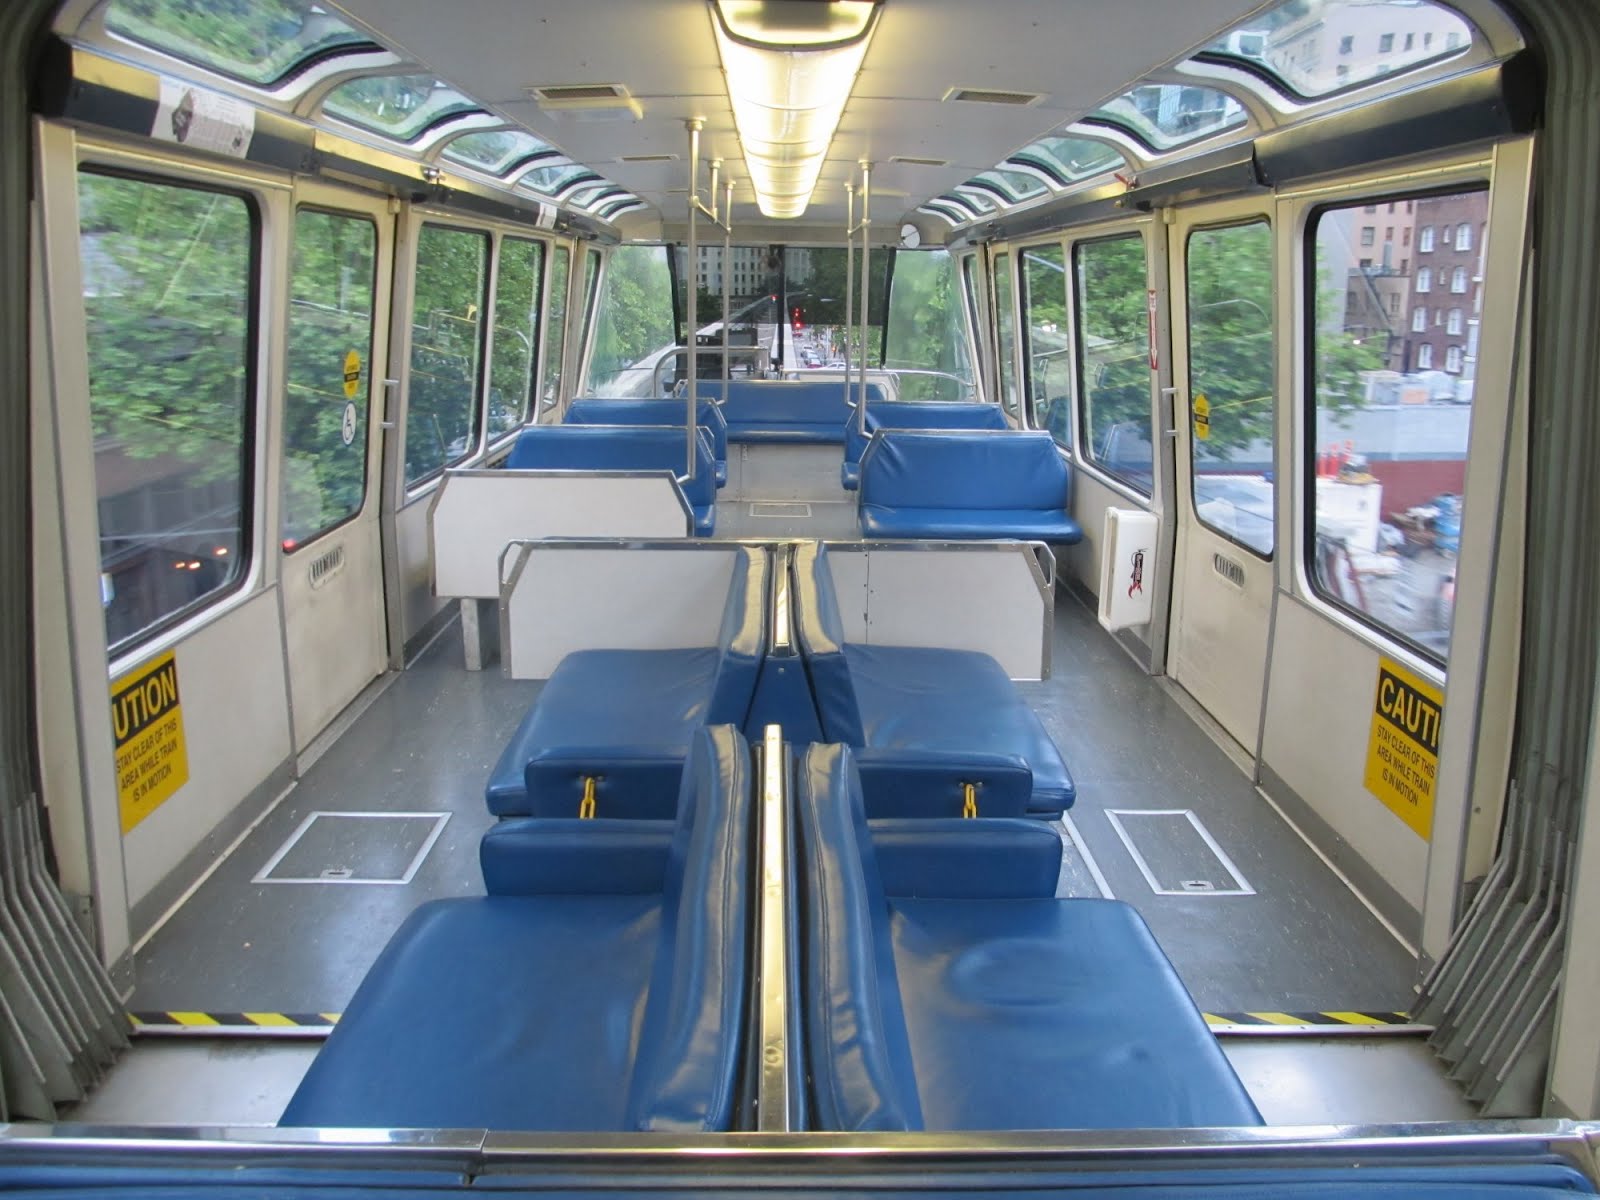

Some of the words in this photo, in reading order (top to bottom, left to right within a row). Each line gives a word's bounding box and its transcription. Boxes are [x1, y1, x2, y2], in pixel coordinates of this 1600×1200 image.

[113, 666, 176, 740] UTION
[1380, 678, 1440, 747] CAUTI
[115, 753, 132, 774] STAY
[133, 739, 154, 761] CLEAR
[154, 730, 165, 746] OF
[164, 718, 177, 735] THIS
[121, 770, 140, 792] AREA
[139, 752, 160, 776] WHILE
[160, 738, 177, 758] TRAIN
[1377, 725, 1391, 743] STAY
[1391, 736, 1411, 760] CLEAR
[1411, 750, 1420, 765] OF
[1421, 759, 1436, 779] THIS
[1377, 745, 1392, 765] AREA
[1392, 754, 1411, 782] WHILE
[1412, 770, 1430, 797] TRAIN
[132, 787, 141, 802] IS
[140, 780, 149, 796] IN
[148, 762, 172, 792] MOTION
[1382, 767, 1389, 782] IS
[1388, 774, 1396, 787] IN
[1394, 778, 1419, 807] MOTION
